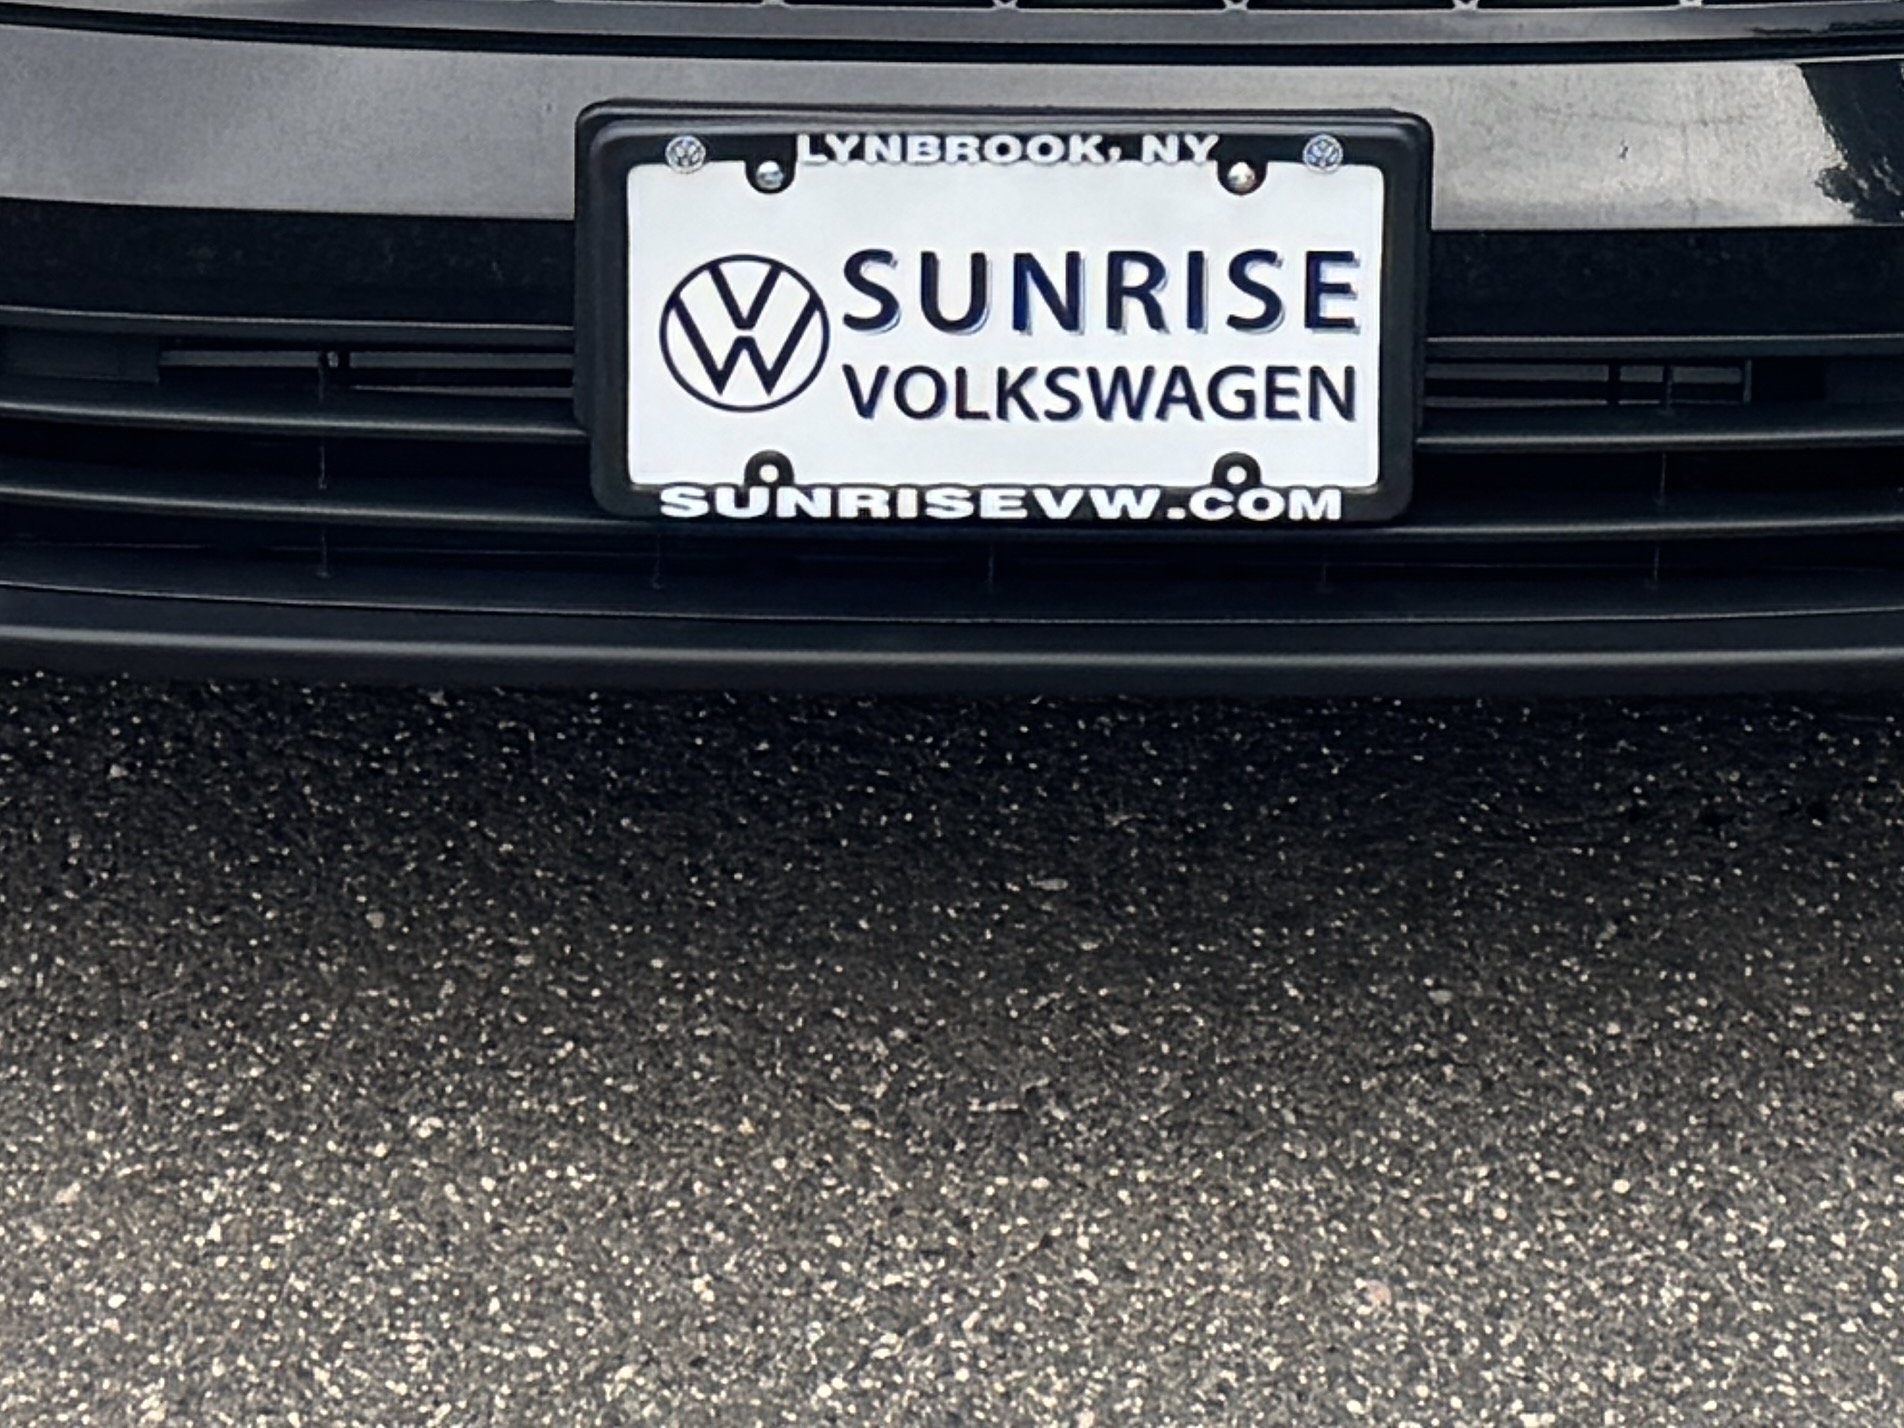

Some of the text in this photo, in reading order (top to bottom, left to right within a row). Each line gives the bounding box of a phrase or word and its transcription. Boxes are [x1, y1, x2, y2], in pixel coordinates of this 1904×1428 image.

[797, 134, 1219, 165] LYNBROOK, NY
[842, 248, 1360, 334] SUNRISE
[659, 253, 831, 413] VW
[842, 364, 1357, 423] VOLKSWAGEN
[659, 485, 1343, 521] SUNRISEVW.COM
